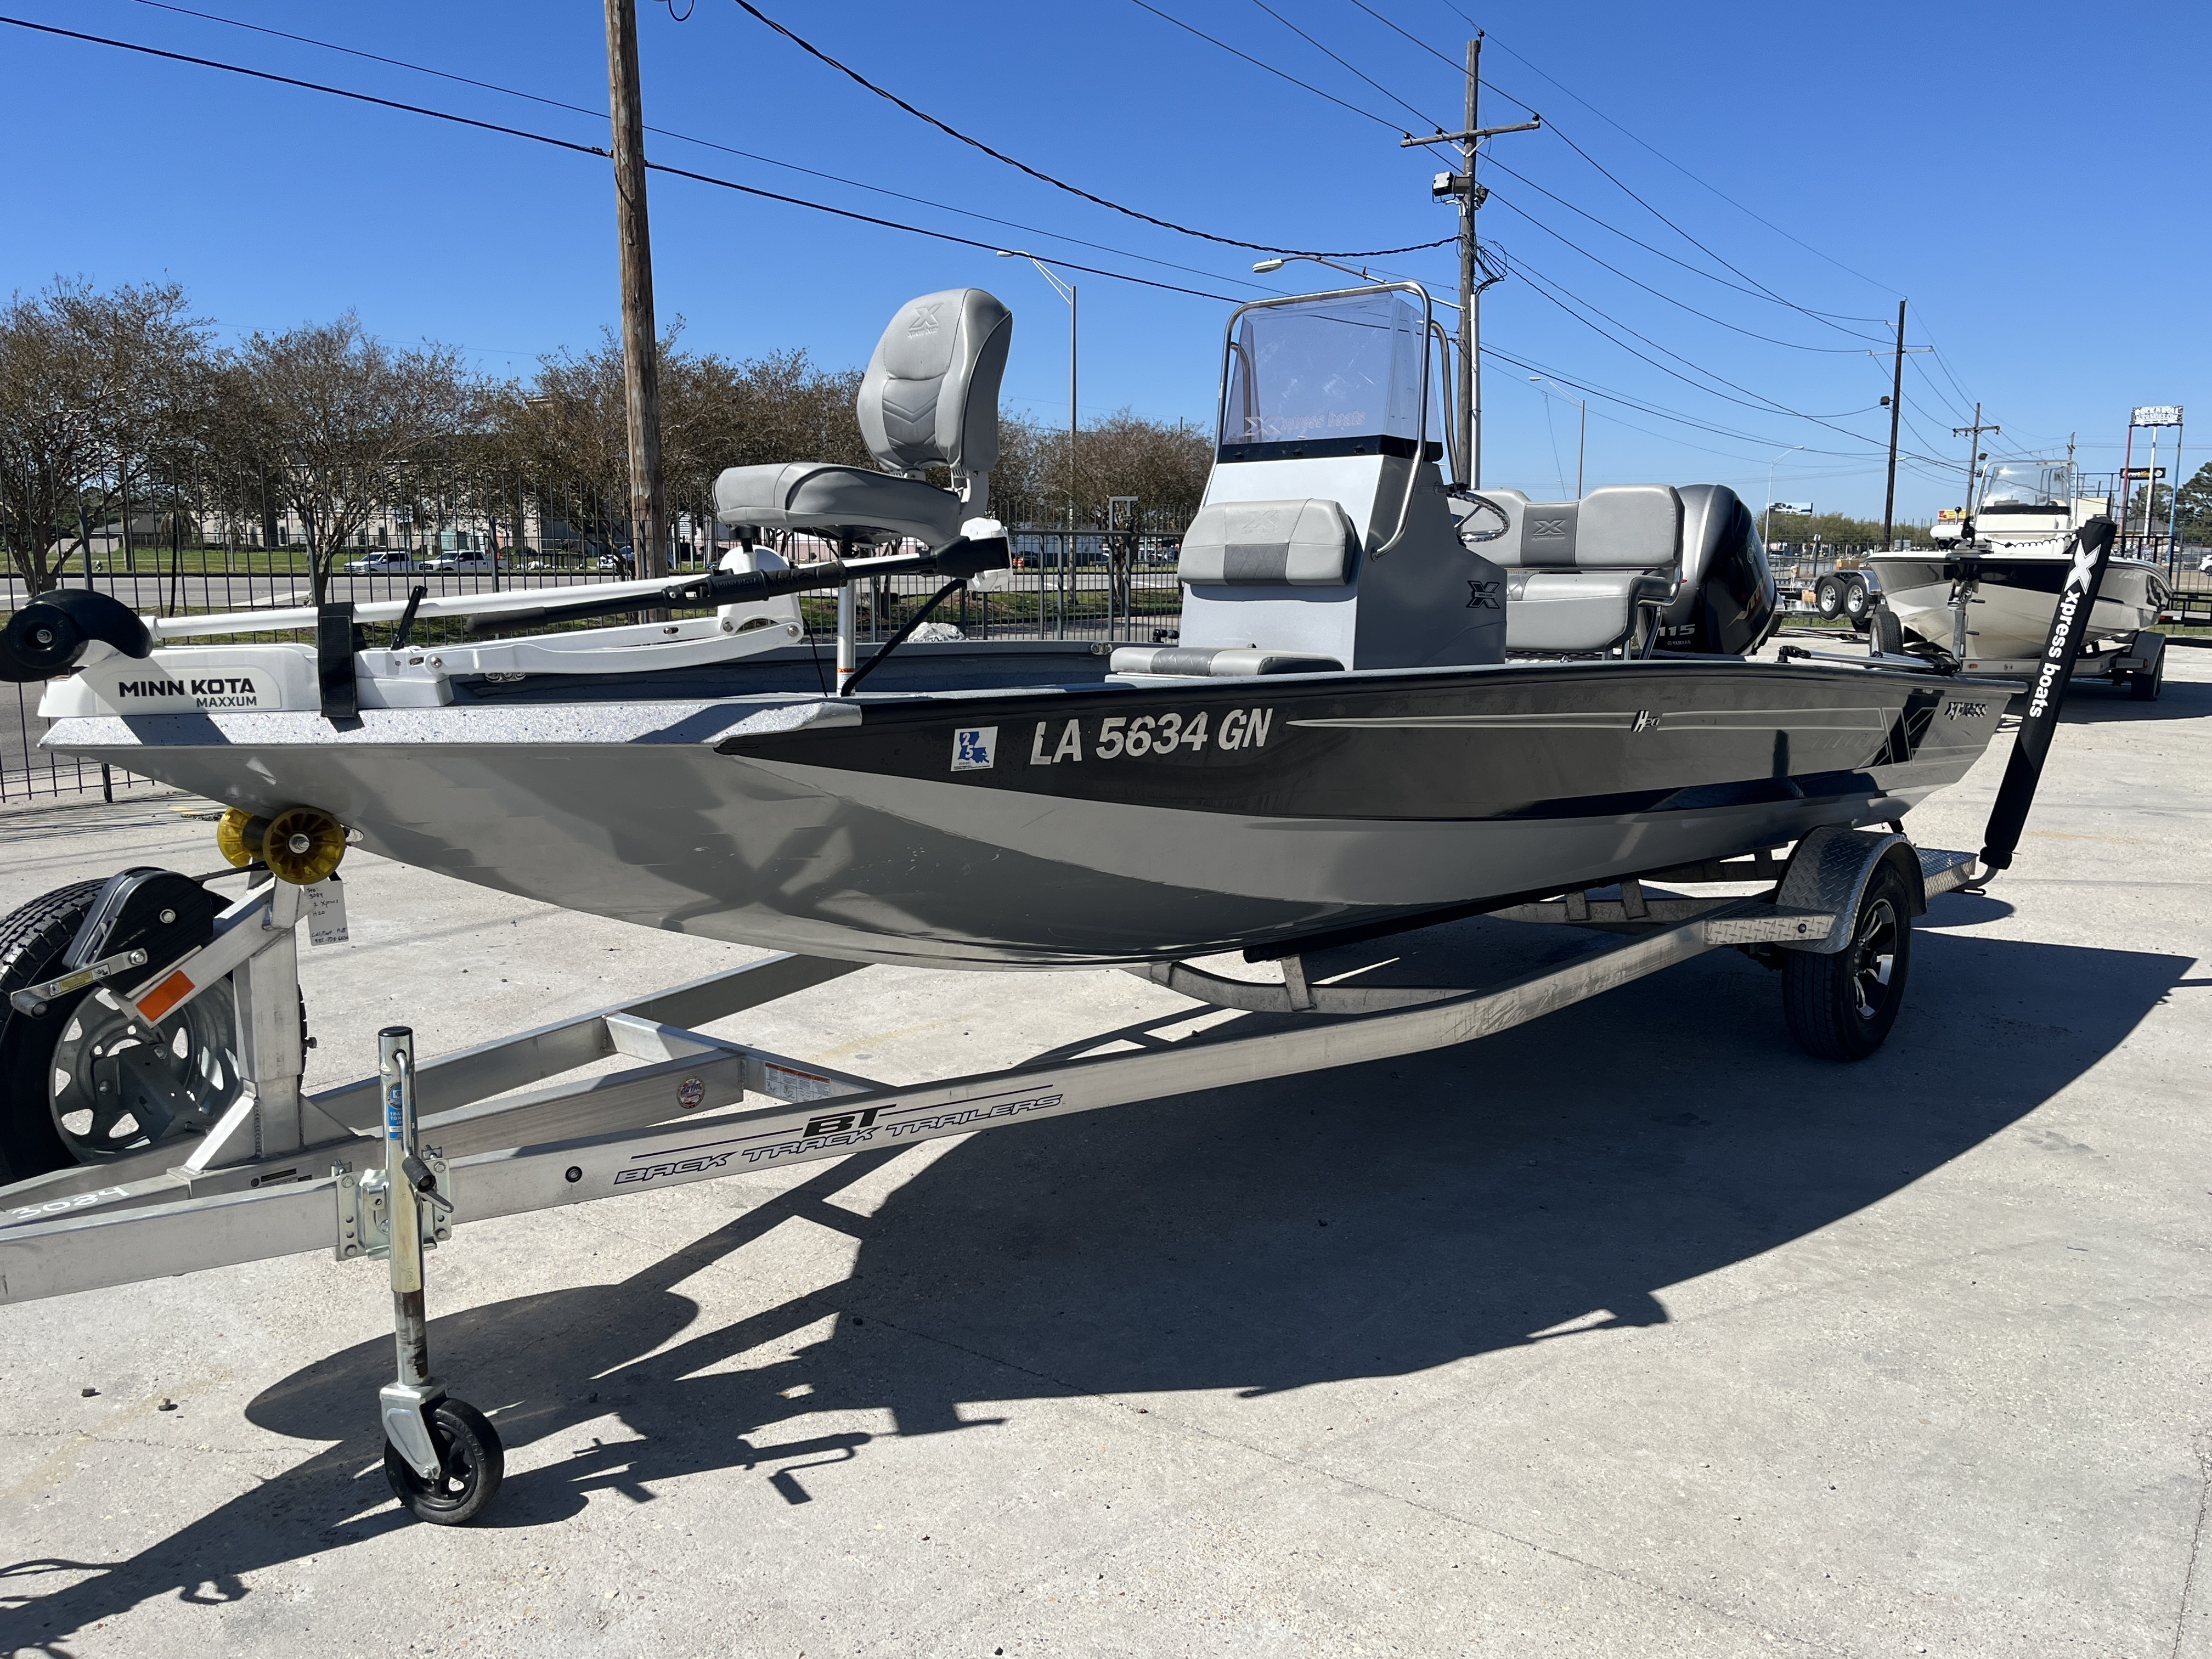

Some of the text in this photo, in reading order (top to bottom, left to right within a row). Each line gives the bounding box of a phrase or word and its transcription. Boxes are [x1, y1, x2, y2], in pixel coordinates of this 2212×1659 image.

[1658, 624, 1696, 636] 115
[2048, 590, 2081, 659] xpress
[119, 678, 256, 697] MINN KOTA
[196, 696, 257, 708] MAXXUM
[2029, 662, 2061, 719] boats
[962, 732, 970, 746] 2
[965, 744, 974, 758] 5
[1029, 708, 1273, 765] LA 5634 GN
[803, 1104, 897, 1137] BT
[614, 1094, 1063, 1185] BACK TRACK TRAILERS
[11, 1187, 131, 1219] 3084
